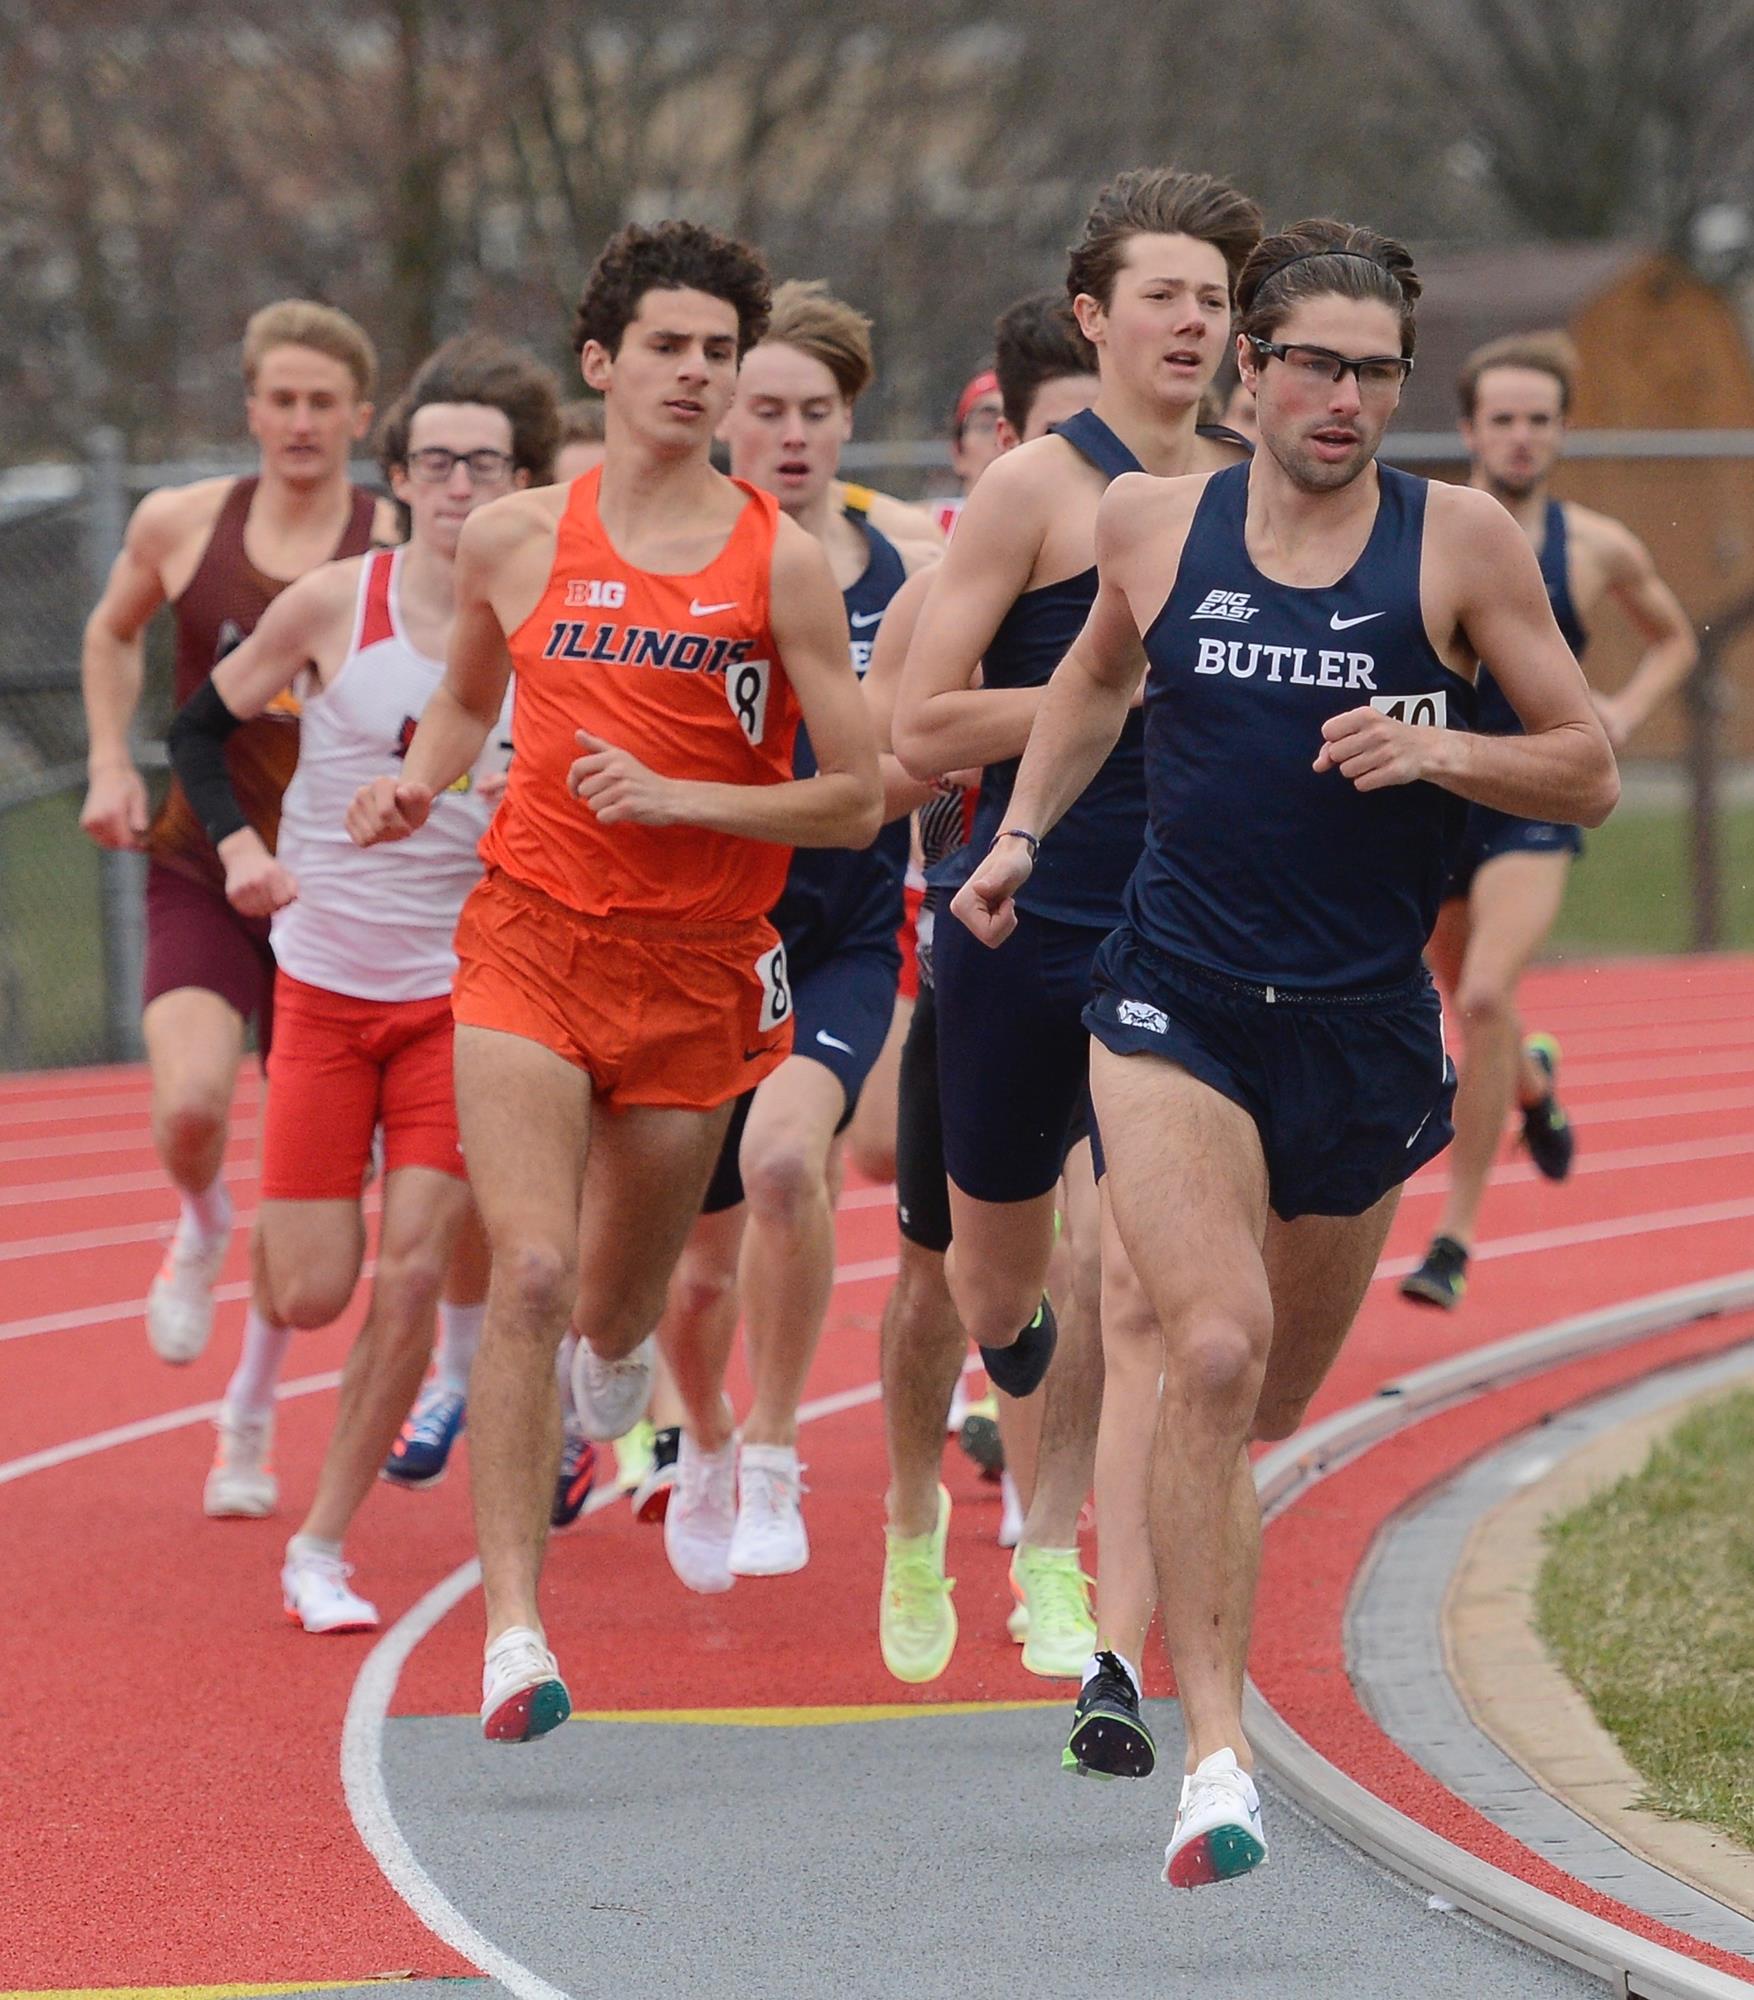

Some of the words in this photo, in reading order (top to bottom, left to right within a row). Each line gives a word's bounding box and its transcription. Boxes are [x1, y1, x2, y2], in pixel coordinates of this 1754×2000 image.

[1194, 602, 1260, 620] EAST
[1204, 589, 1252, 606] BIG
[542, 619, 756, 677] ILLINOIS
[1194, 638, 1378, 691] BUTLER
[735, 666, 761, 735] 8
[771, 951, 788, 1020] 8
